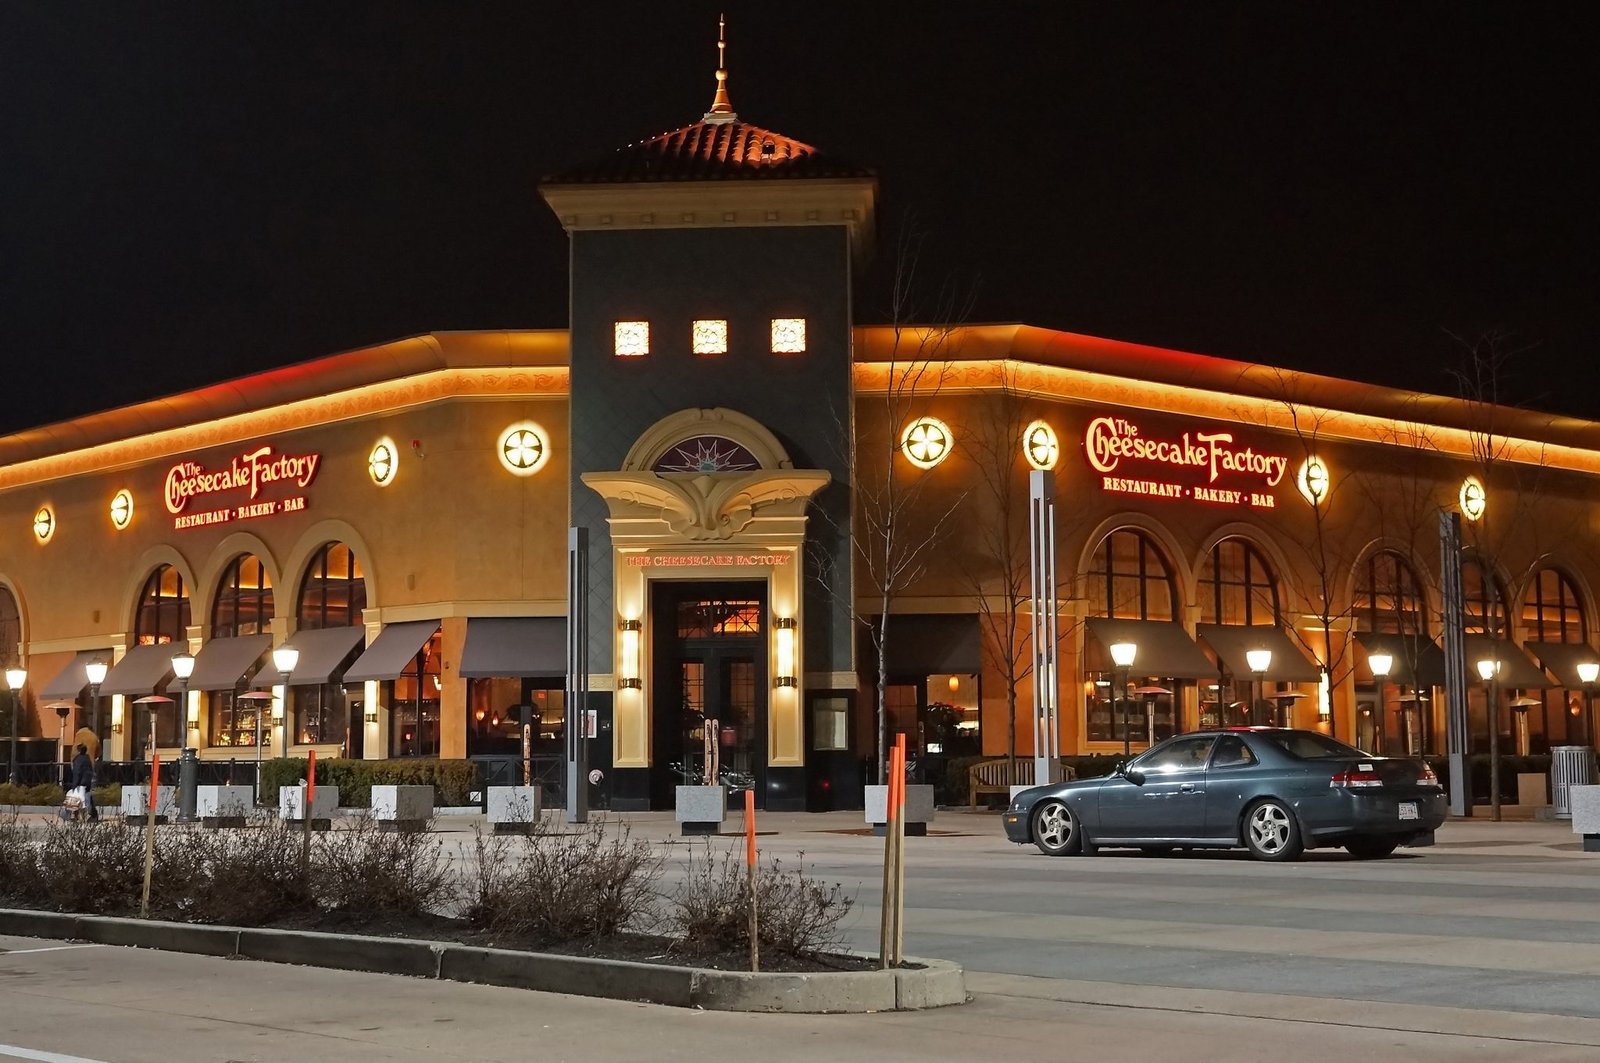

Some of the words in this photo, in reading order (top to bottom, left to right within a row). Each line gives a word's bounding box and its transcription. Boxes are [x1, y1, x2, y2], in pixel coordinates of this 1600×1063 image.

[1115, 419, 1138, 438] The
[1086, 417, 1209, 473] Cheesecake
[1197, 433, 1288, 487] Factory
[164, 457, 250, 514] Cheesecake
[242, 446, 319, 500] Factory
[185, 462, 201, 477] The
[1103, 476, 1182, 498] RESTAURANT
[1194, 486, 1242, 504] BAKERY
[1251, 493, 1275, 508] BAR
[175, 509, 230, 529] RESTAURANT
[238, 501, 276, 519] BAKERY
[284, 497, 305, 512] BAR
[626, 556, 651, 567] THE
[653, 556, 733, 567] CHEESECAKE
[736, 555, 791, 566] FACTORY
